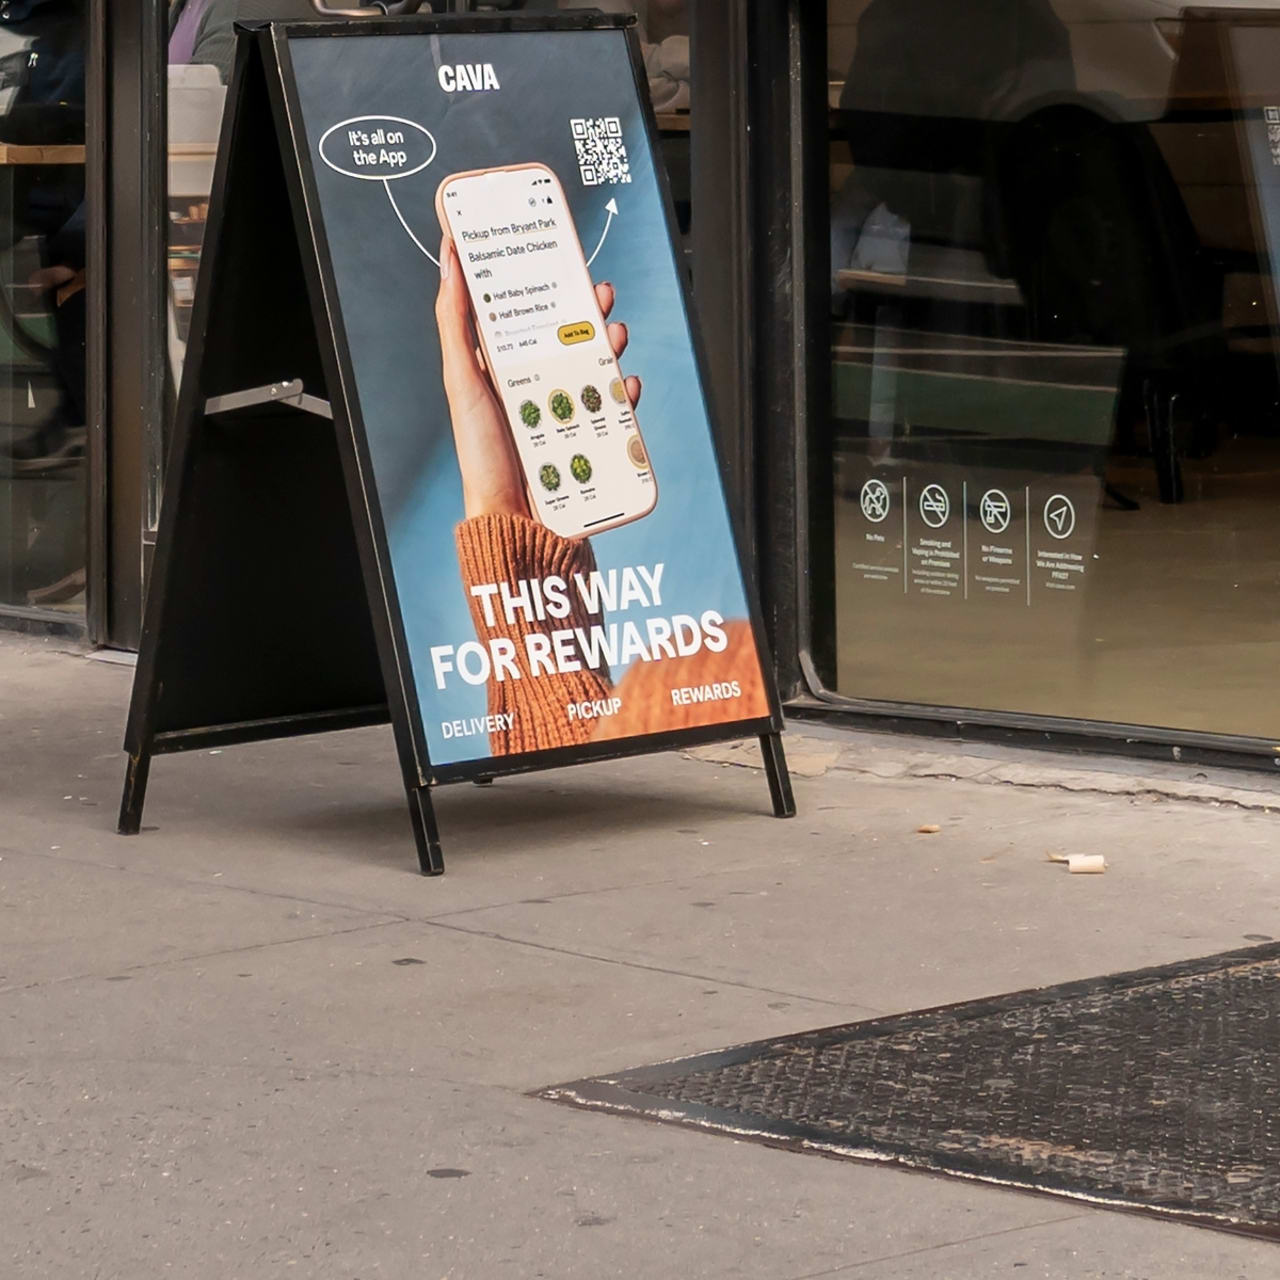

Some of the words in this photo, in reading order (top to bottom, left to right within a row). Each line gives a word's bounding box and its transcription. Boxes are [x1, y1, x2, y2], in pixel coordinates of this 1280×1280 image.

[438, 63, 500, 92] CAVA
[348, 130, 370, 146] It's
[370, 129, 385, 145] all
[387, 131, 404, 144] on
[353, 150, 377, 166] the
[379, 148, 407, 168] App
[461, 229, 490, 241] Pickup
[490, 226, 510, 237] from
[511, 222, 538, 234] Bryant
[538, 218, 556, 229] Park
[468, 248, 505, 263] Balsamic
[506, 244, 525, 257] Date
[526, 240, 558, 253] Chicken
[474, 268, 493, 280] with
[507, 376, 532, 388] Greens
[471, 575, 570, 628] THIS
[573, 563, 664, 615] WAY
[430, 637, 521, 690] FOR
[523, 609, 728, 678] REWARDS
[671, 680, 742, 707] REWARDS
[567, 697, 622, 722] PICKUP
[441, 712, 515, 740] DELIVERY
